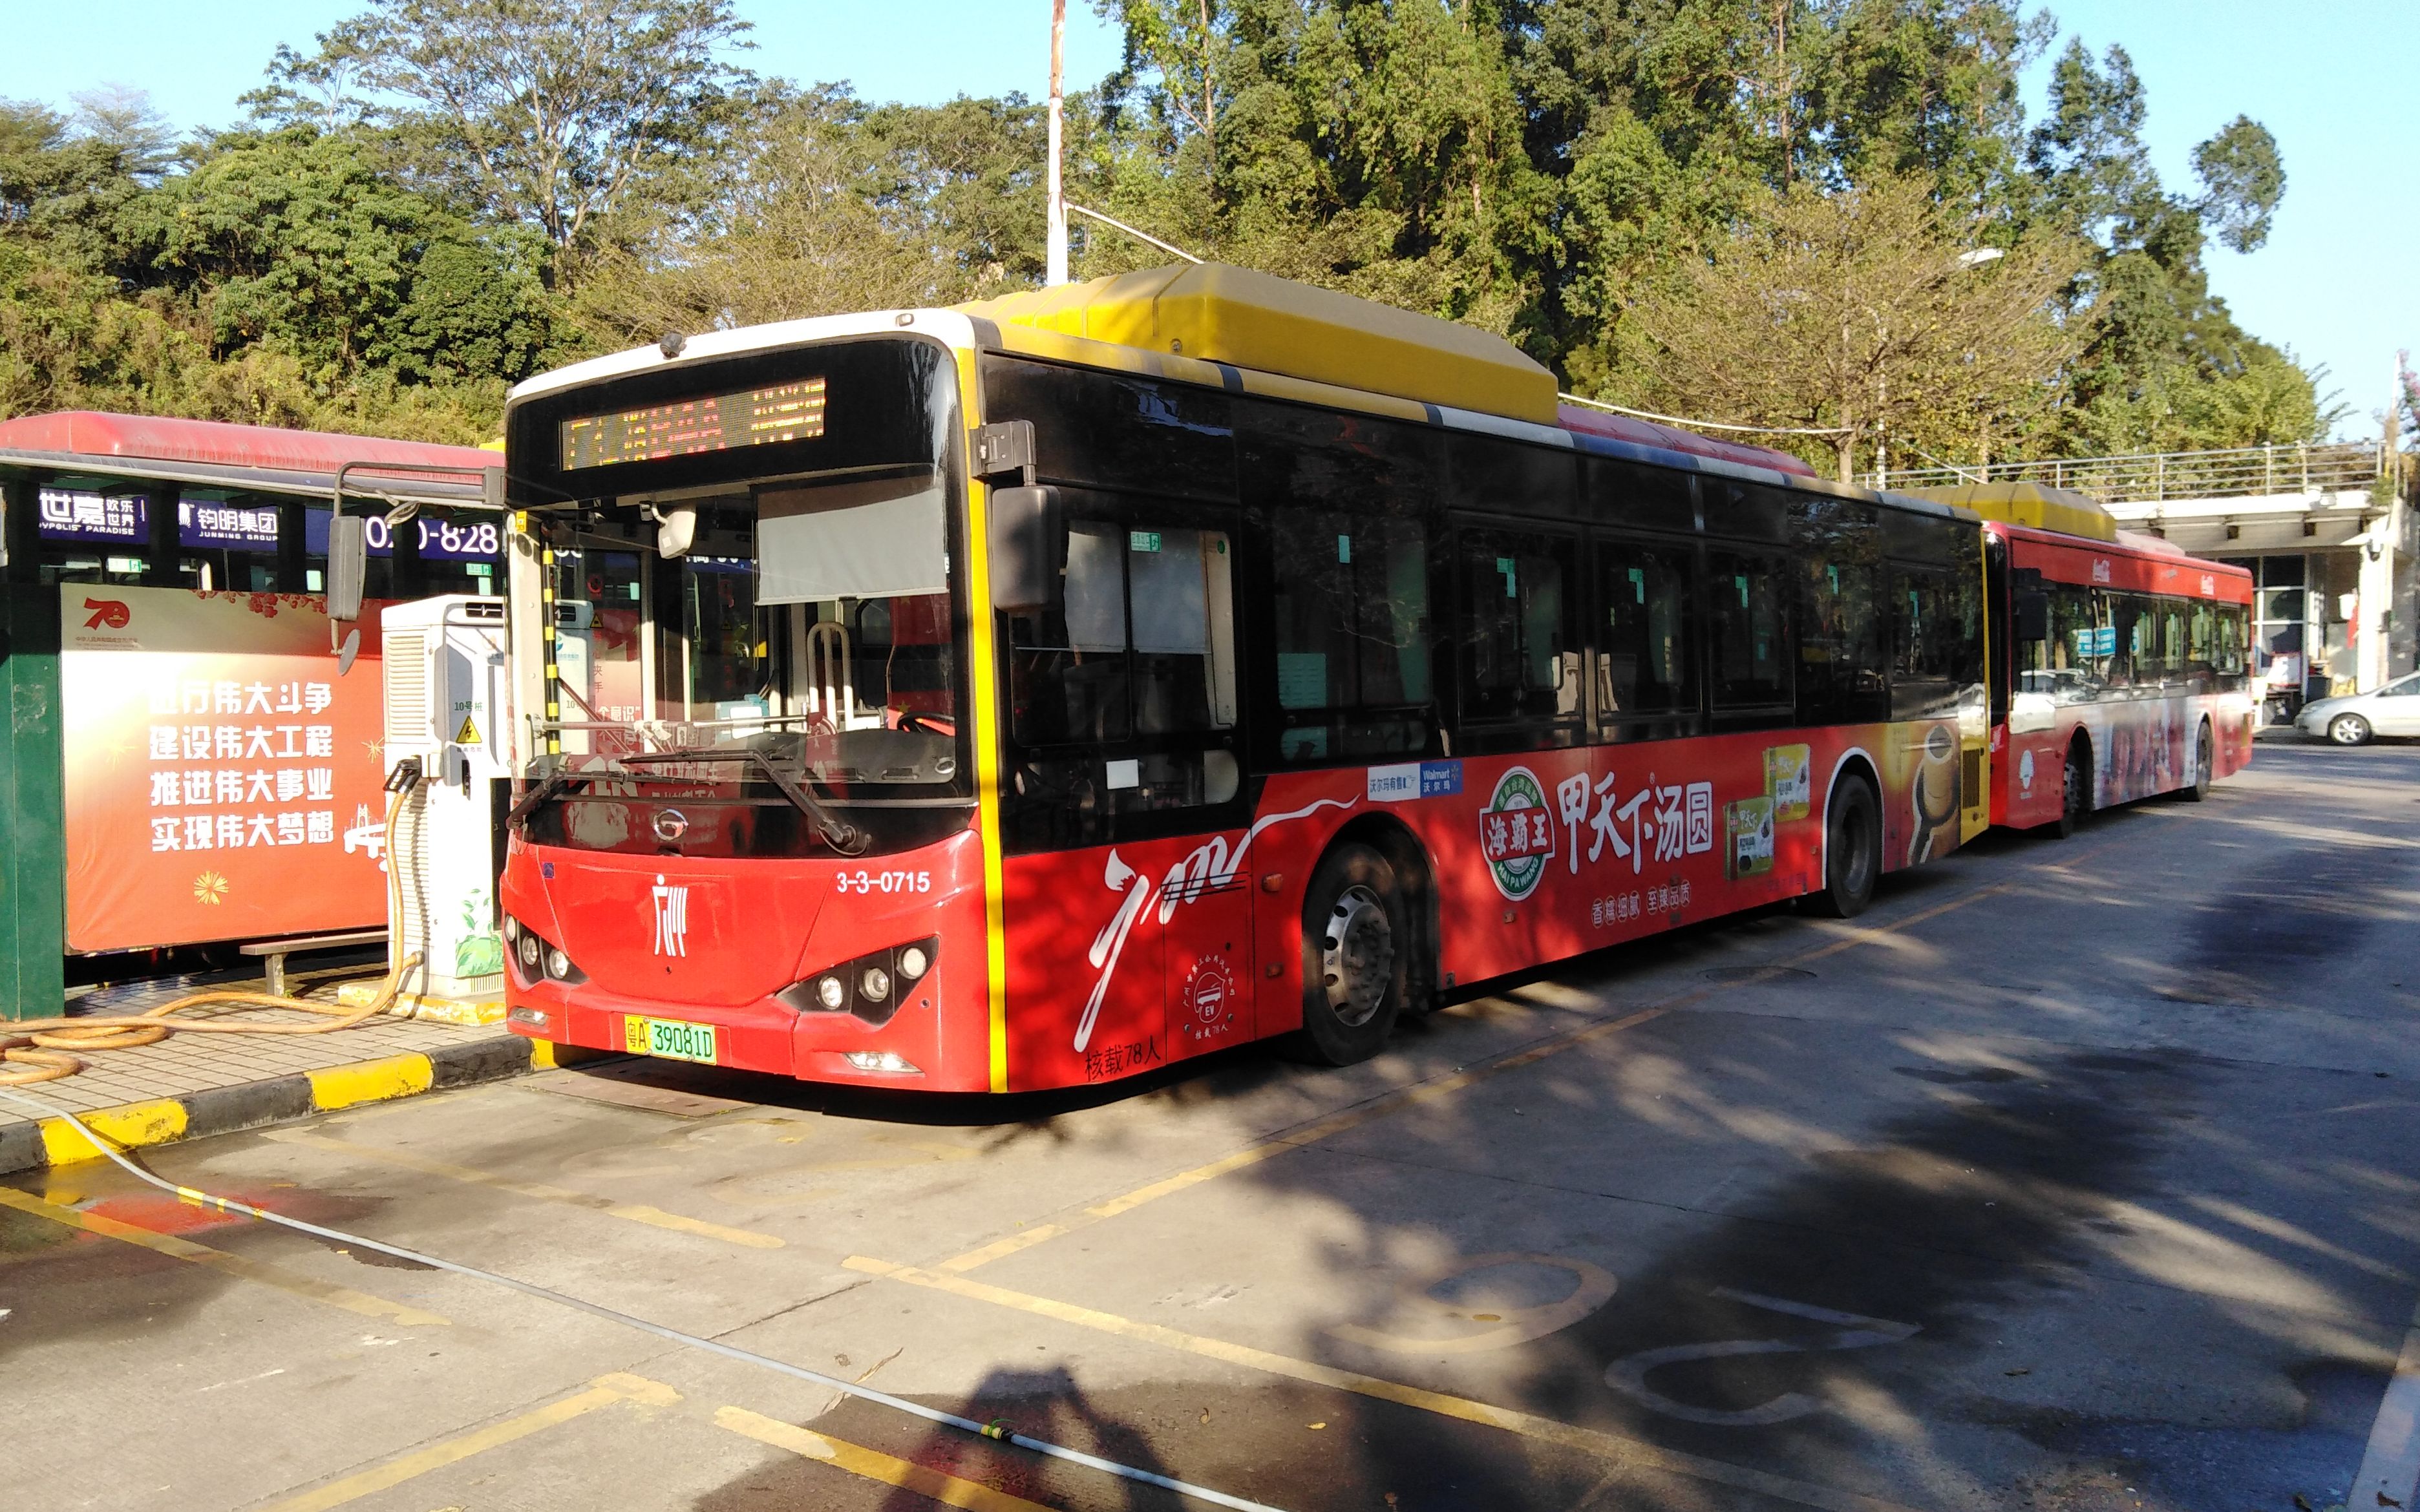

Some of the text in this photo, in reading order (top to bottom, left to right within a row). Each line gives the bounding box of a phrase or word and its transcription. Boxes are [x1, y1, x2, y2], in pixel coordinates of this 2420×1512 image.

[39, 493, 105, 525] 世嘉
[106, 499, 134, 512] 欢乐
[39, 523, 134, 535] YPOLIS PARADISE
[107, 514, 134, 527] 世界
[197, 509, 277, 533] 钧明集团
[199, 531, 241, 540] JUNMING
[148, 681, 332, 715] 行伟大斗争
[149, 725, 333, 761] 建设伟大工程
[1369, 777, 1403, 793] 沃尔玛有售
[1423, 768, 1450, 781] Walmart
[1423, 780, 1450, 793] 沃尔玛
[149, 768, 334, 806] 推进伟大事业
[151, 811, 334, 852] 实现伟大梦想
[1487, 812, 1548, 857] 海霸王
[1556, 771, 1713, 876] 甲天下汤圆
[836, 871, 931, 893] 3-3-0715
[1205, 1005, 1215, 1017] EV
[627, 1021, 713, 1058] 粤A 39081D
[1084, 1034, 1162, 1082] 核载78人
